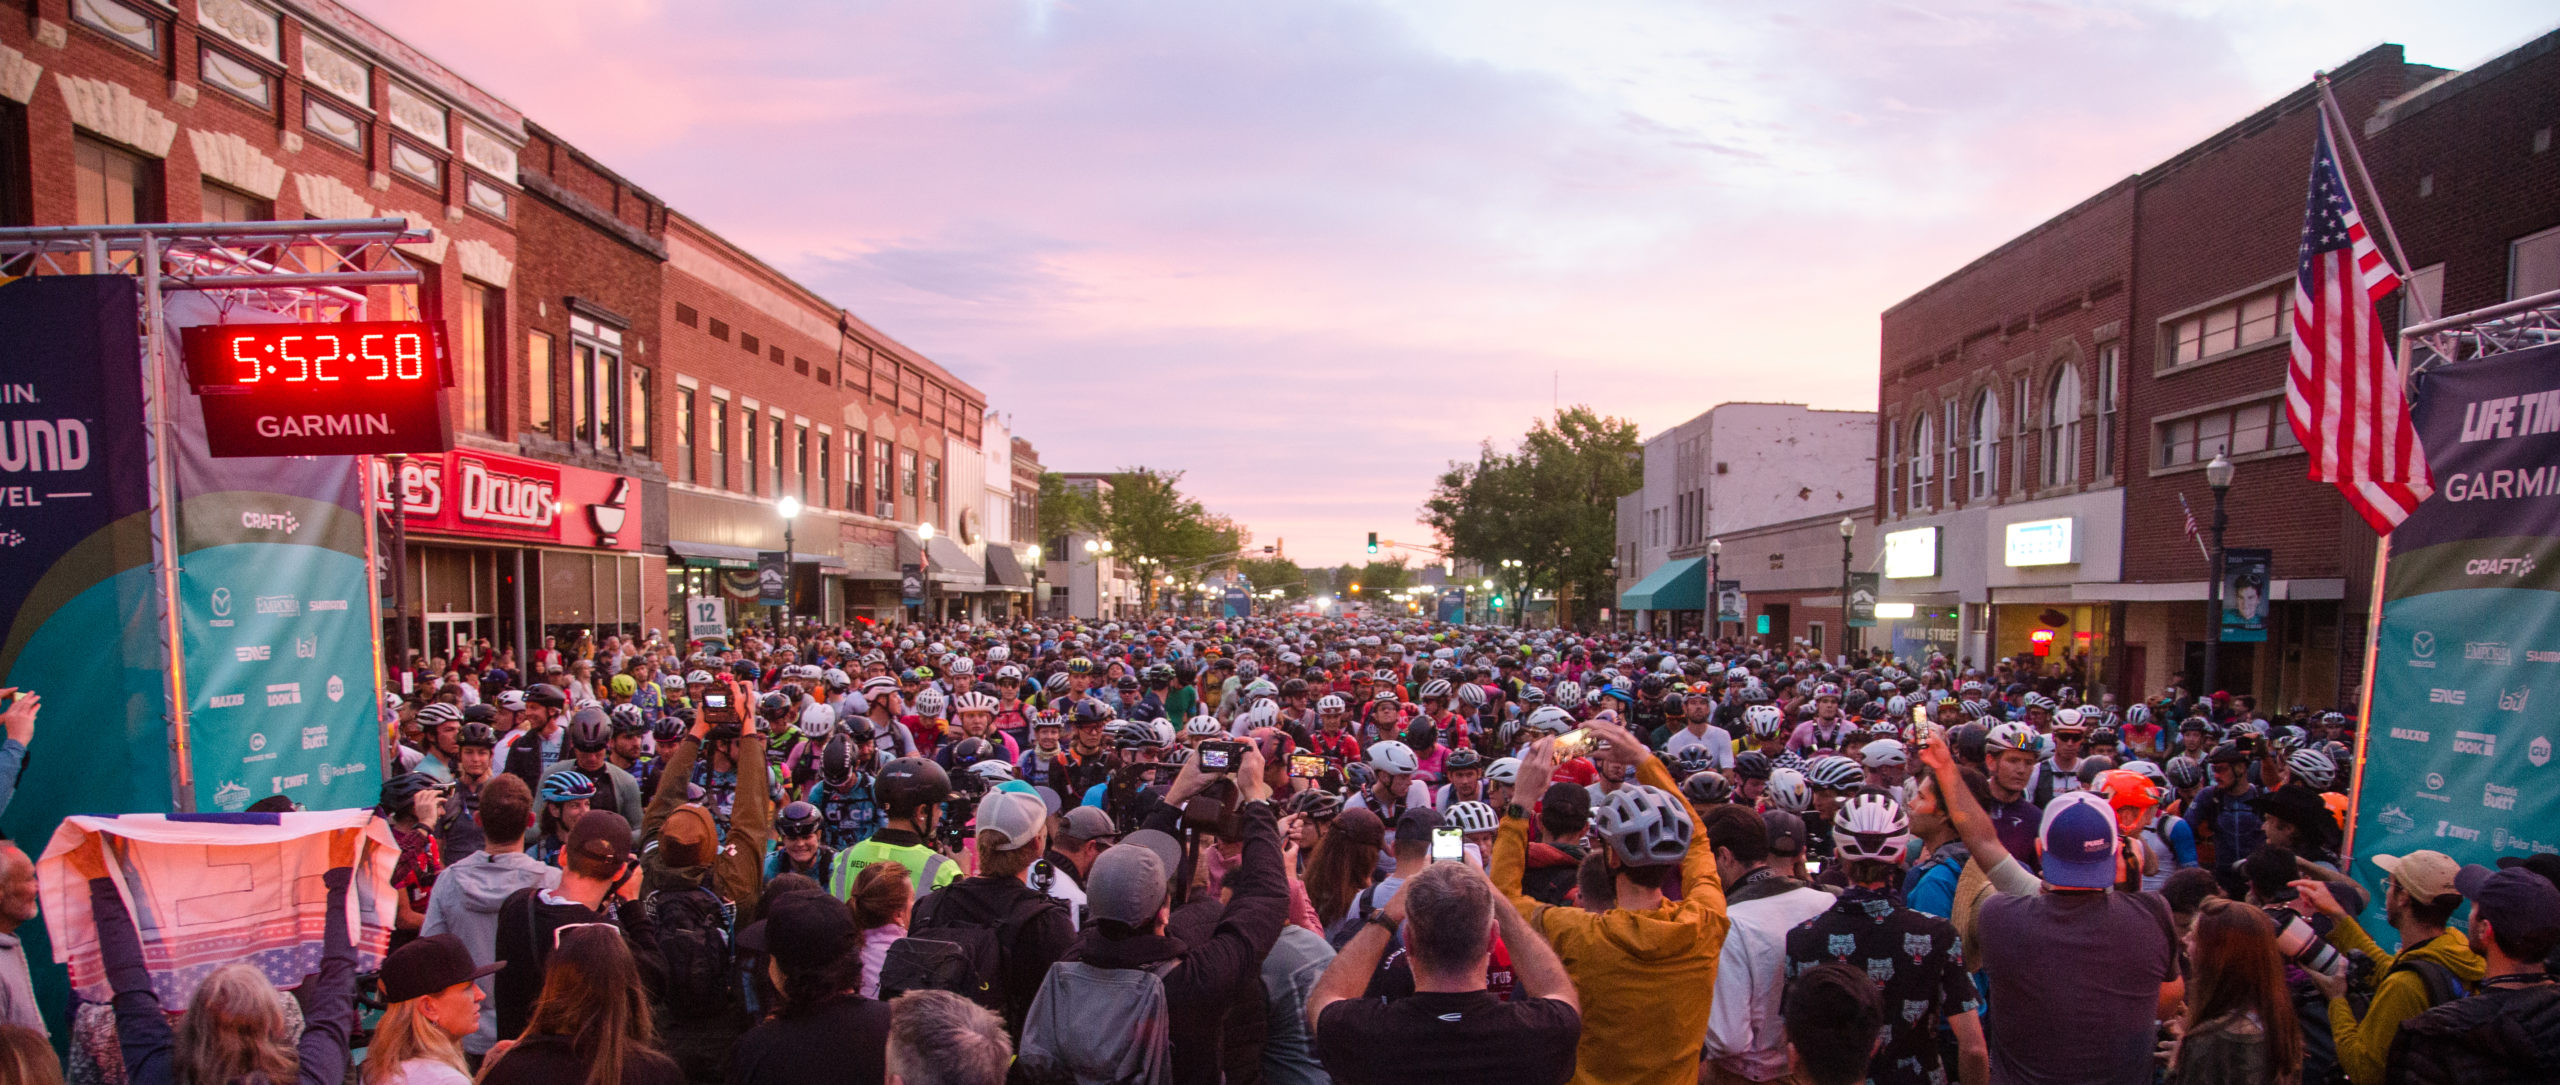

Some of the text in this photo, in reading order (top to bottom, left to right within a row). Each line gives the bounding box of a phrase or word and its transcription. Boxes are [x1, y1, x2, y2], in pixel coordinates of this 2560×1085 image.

[2460, 396, 2520, 443] LIFE
[2445, 465, 2560, 502] GARMI
[462, 464, 554, 527] Drugs
[242, 511, 286, 530] CRAFT
[2465, 558, 2522, 575] CRAFT
[697, 603, 716, 622] 12
[694, 624, 722, 635] HOURS
[1904, 628, 1926, 640] MAIN
[210, 694, 245, 708] MAXXIS
[267, 693, 292, 707] LOOK
[2390, 727, 2430, 743] MAXXIS
[2453, 740, 2483, 755] LOOK
[2508, 835, 2530, 850] Polar
[1492, 971, 1512, 984] PUB
